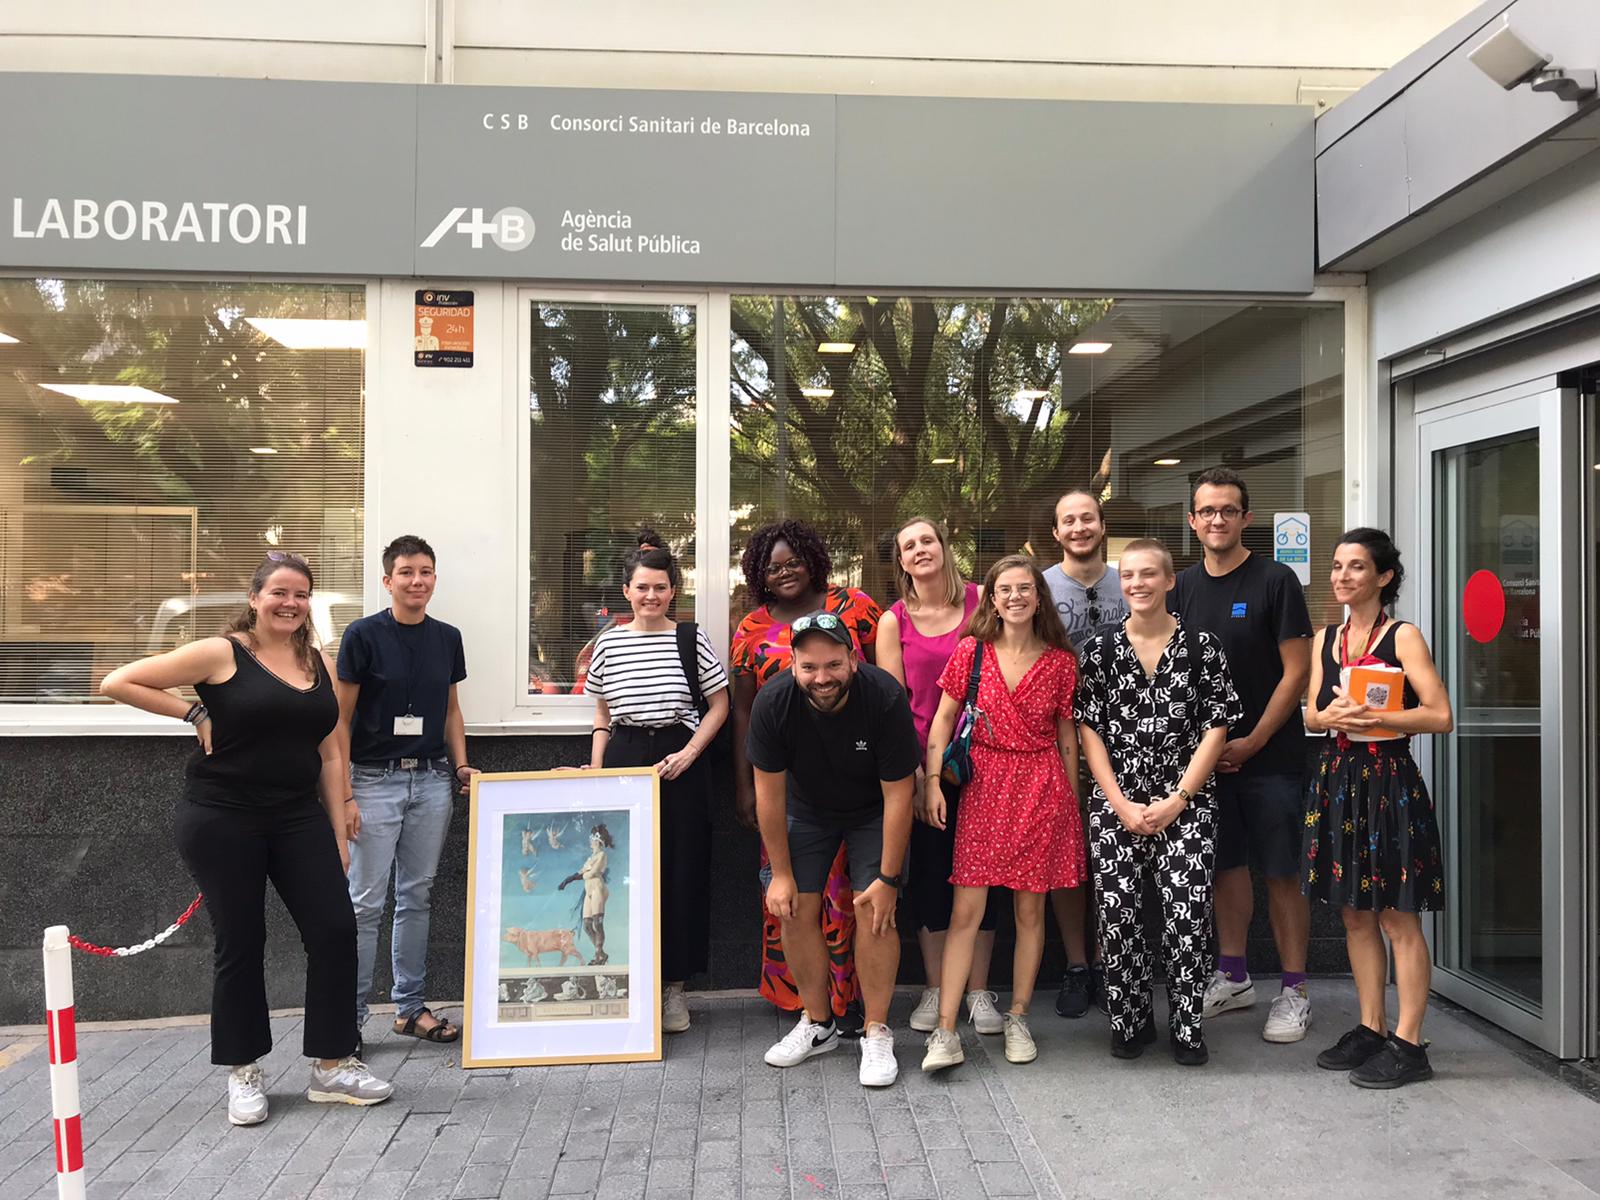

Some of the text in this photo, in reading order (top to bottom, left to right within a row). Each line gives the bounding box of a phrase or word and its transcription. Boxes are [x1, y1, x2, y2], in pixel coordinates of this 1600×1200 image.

[550, 114, 624, 132] Consorci
[629, 116, 695, 134] Sanitari
[700, 116, 722, 134] de
[727, 118, 811, 137] Barcelona
[12, 198, 307, 245] LABORATORI
[561, 210, 632, 232] Agència
[561, 233, 700, 254] de Salut Pública
[418, 307, 470, 317] SEGURIDAD
